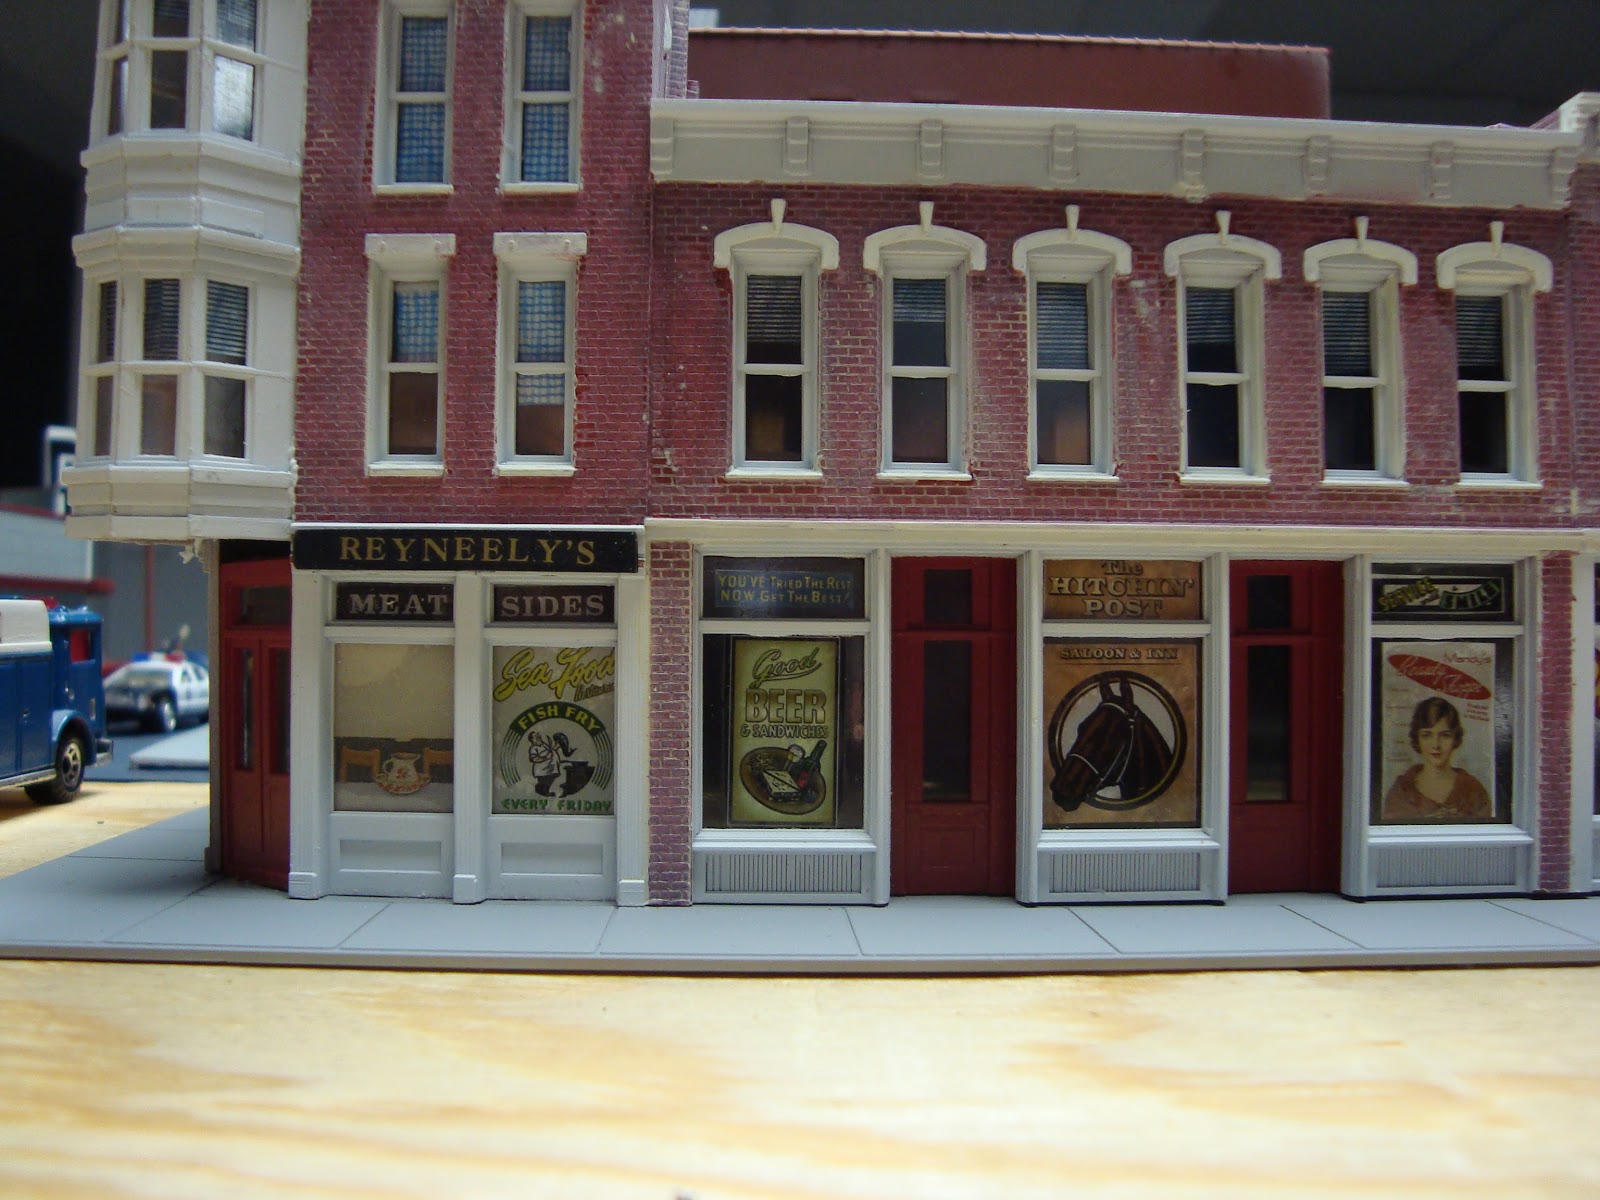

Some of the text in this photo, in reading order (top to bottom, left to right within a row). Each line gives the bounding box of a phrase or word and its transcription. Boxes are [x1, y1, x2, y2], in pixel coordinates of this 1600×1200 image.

[339, 536, 596, 565] REYNEELY'S
[1102, 560, 1143, 575] The
[718, 575, 766, 588] YOU'VE
[1049, 577, 1195, 597] HITCHIN'
[349, 594, 448, 616] MEAT
[720, 589, 755, 601] NOW
[501, 595, 605, 618] SIDES
[1083, 598, 1164, 618] POST
[1060, 648, 1178, 660] SALOON & INN
[493, 646, 615, 701] Sea Food
[749, 647, 822, 688] Good
[745, 688, 827, 724] BEER
[518, 704, 601, 732] FISH FRY
[740, 724, 829, 739] & SANDWICHES
[501, 799, 612, 812] EVERY FRIDAY
